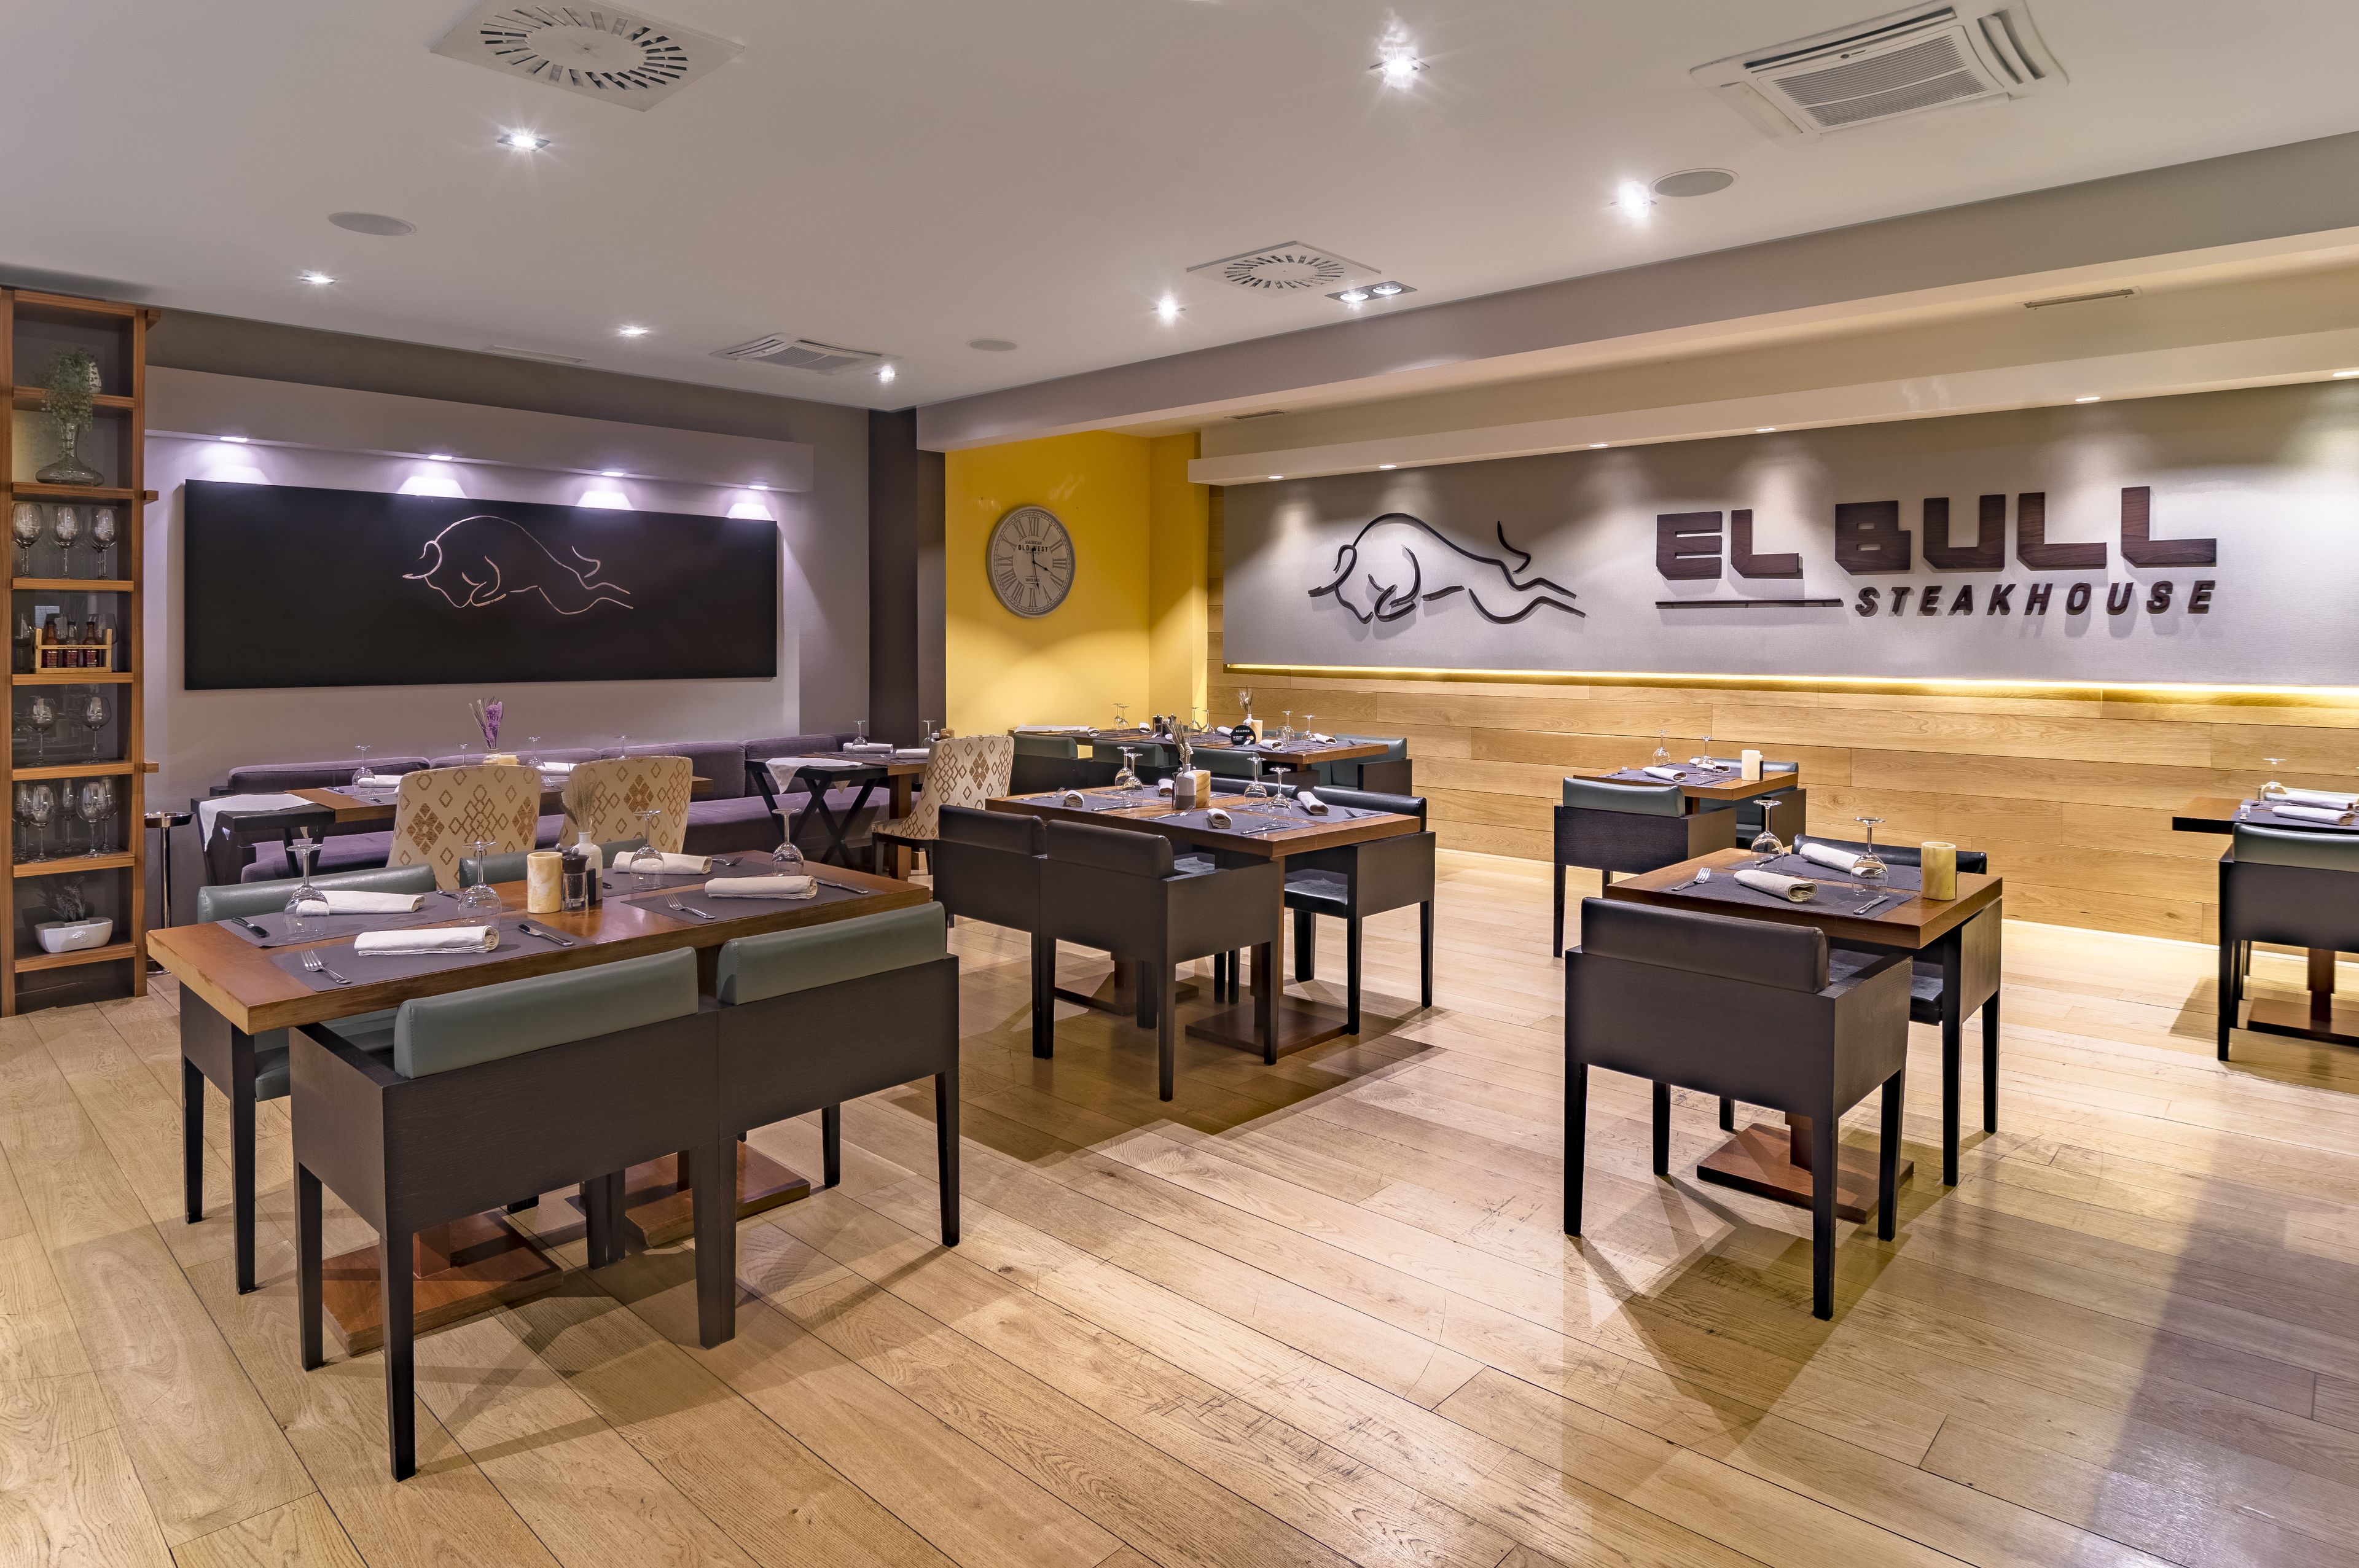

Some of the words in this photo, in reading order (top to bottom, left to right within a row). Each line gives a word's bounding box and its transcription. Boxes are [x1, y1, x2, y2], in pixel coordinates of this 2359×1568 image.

[1012, 519, 1027, 541] XI
[1027, 517, 1039, 537] XII
[1042, 523, 1052, 541] I
[1656, 509, 1801, 580] EL
[1834, 486, 2216, 575] BULL
[1001, 535, 1017, 551] X
[1049, 538, 1064, 553] II
[998, 554, 1014, 567] IX
[1052, 557, 1067, 570] III
[1855, 580, 2215, 617] STEAKHOUSE
